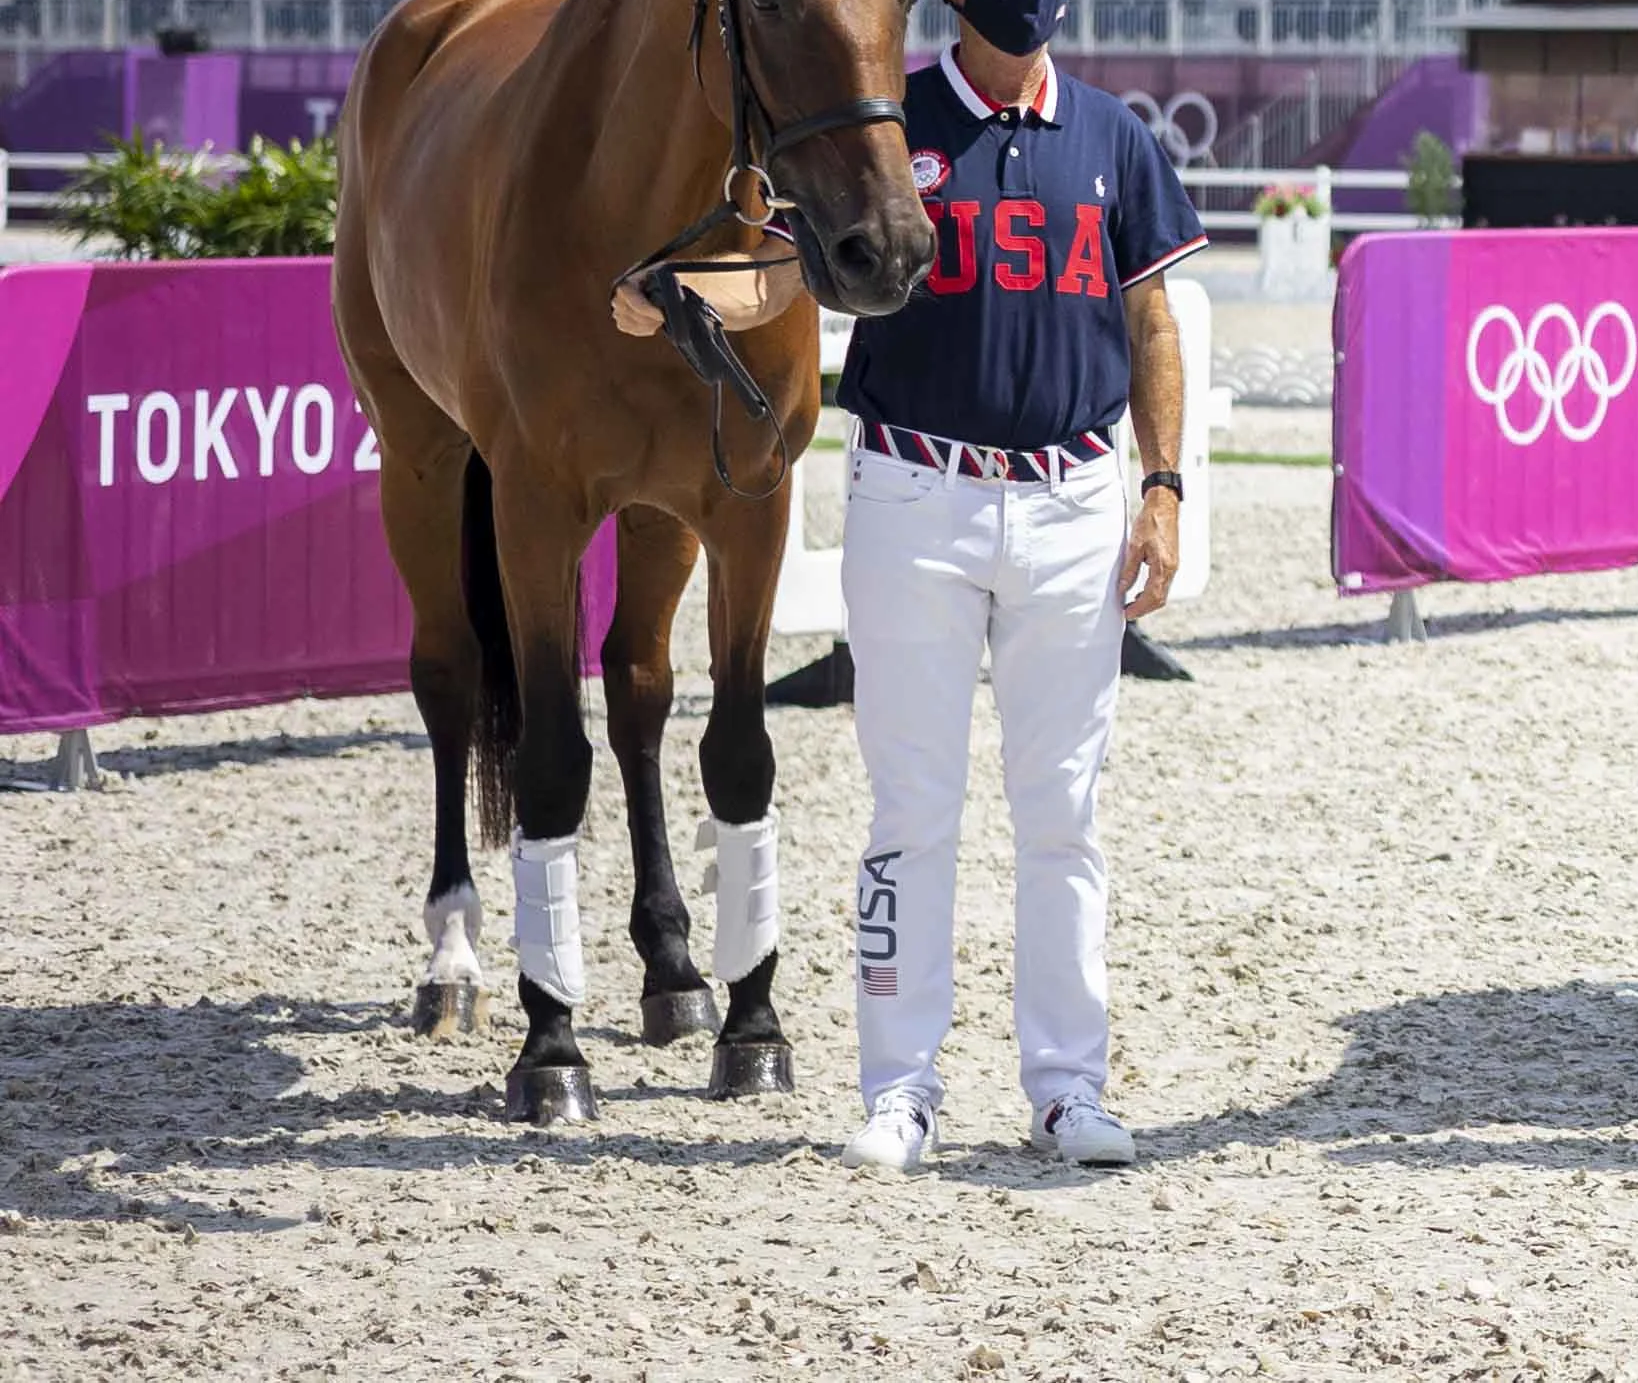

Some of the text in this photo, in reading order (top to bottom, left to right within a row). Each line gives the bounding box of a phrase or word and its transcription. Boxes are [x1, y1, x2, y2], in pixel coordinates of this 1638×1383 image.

[920, 199, 1109, 299] USA
[87, 382, 334, 487] TOKYO
[858, 850, 903, 961] USA
